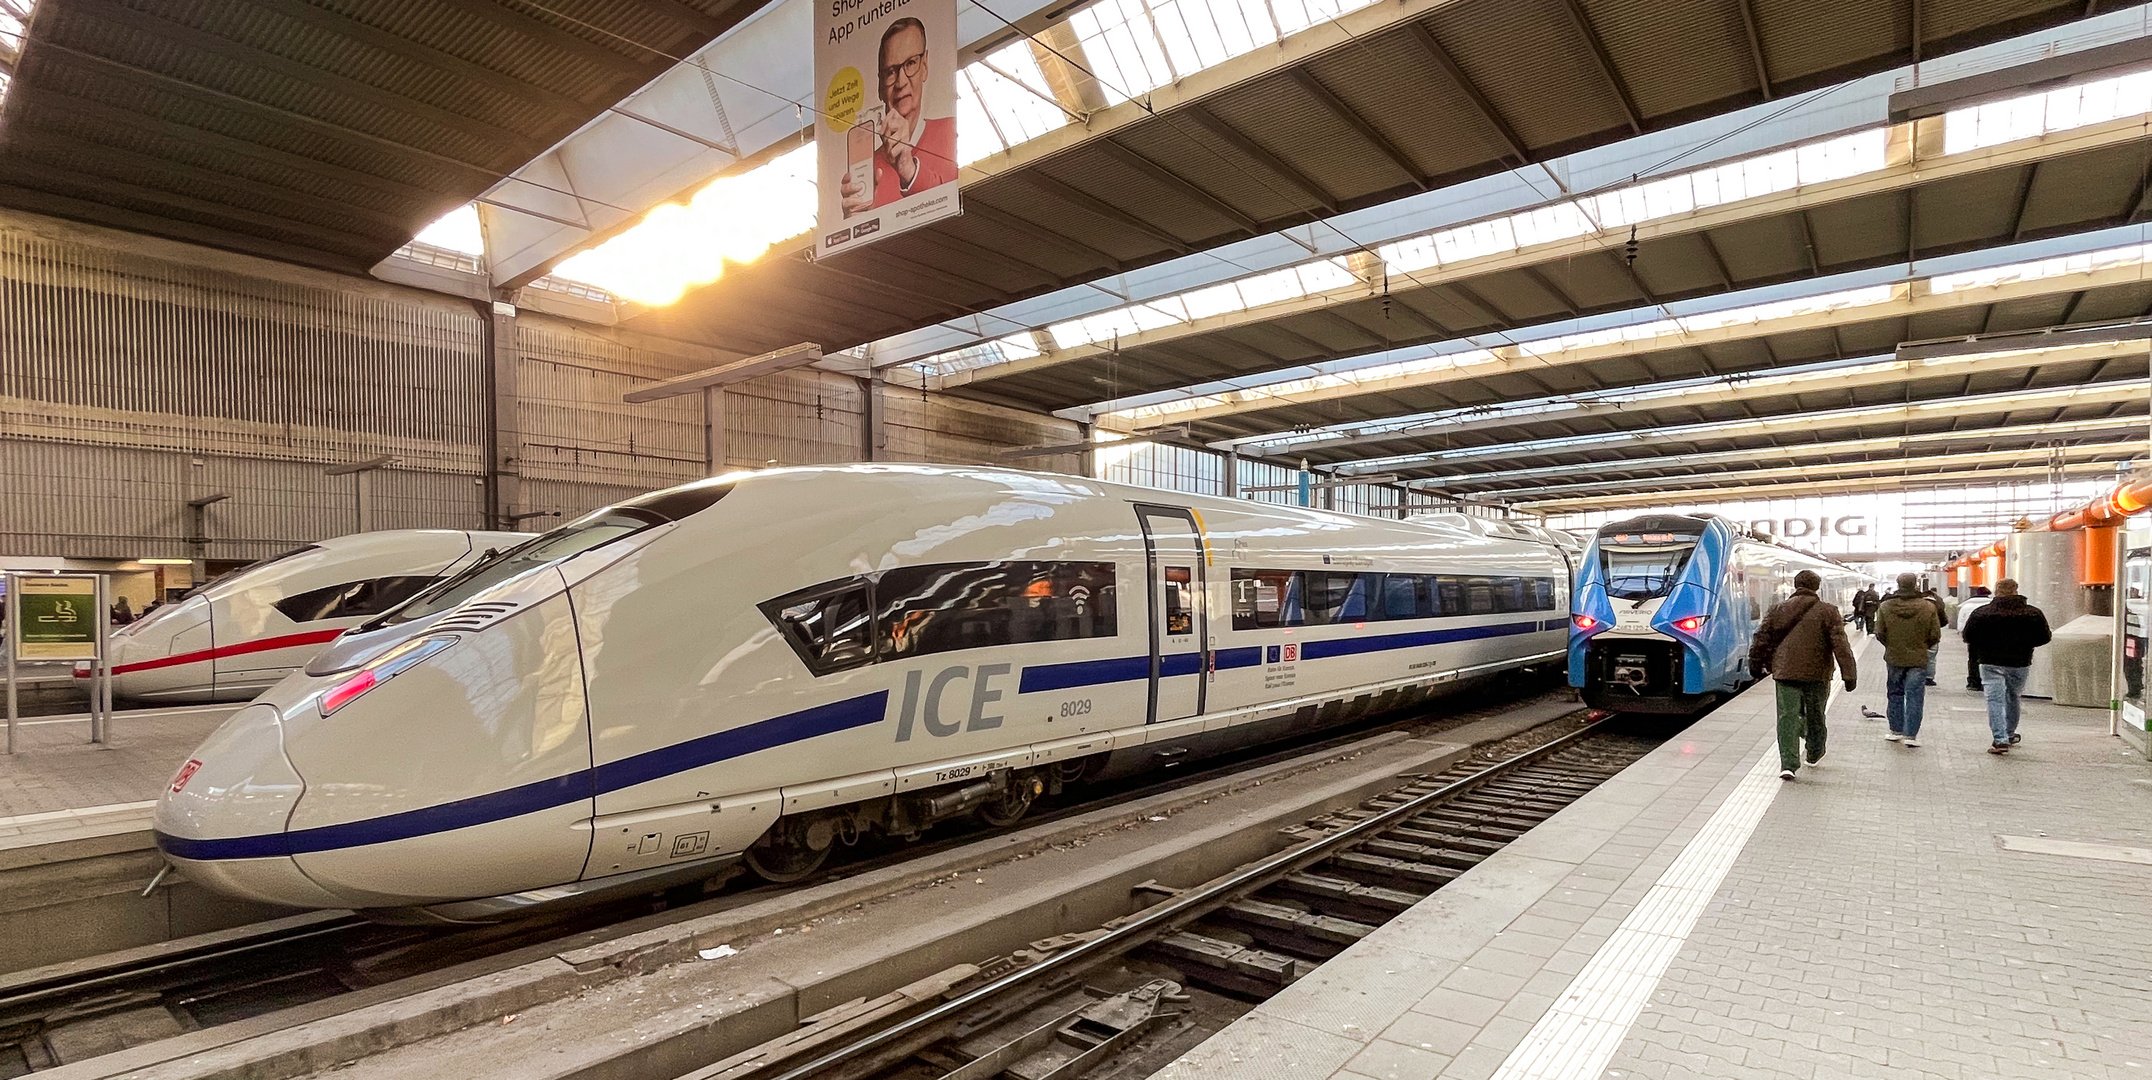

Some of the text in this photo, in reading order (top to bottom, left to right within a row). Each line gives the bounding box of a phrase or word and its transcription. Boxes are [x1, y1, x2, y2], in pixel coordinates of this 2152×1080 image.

[828, 22, 854, 45] App
[1285, 645, 1296, 660] DB
[895, 663, 1012, 743] ICE
[1060, 699, 1092, 718] 8029
[935, 771, 948, 782] Tz
[948, 766, 971, 780] 8029
